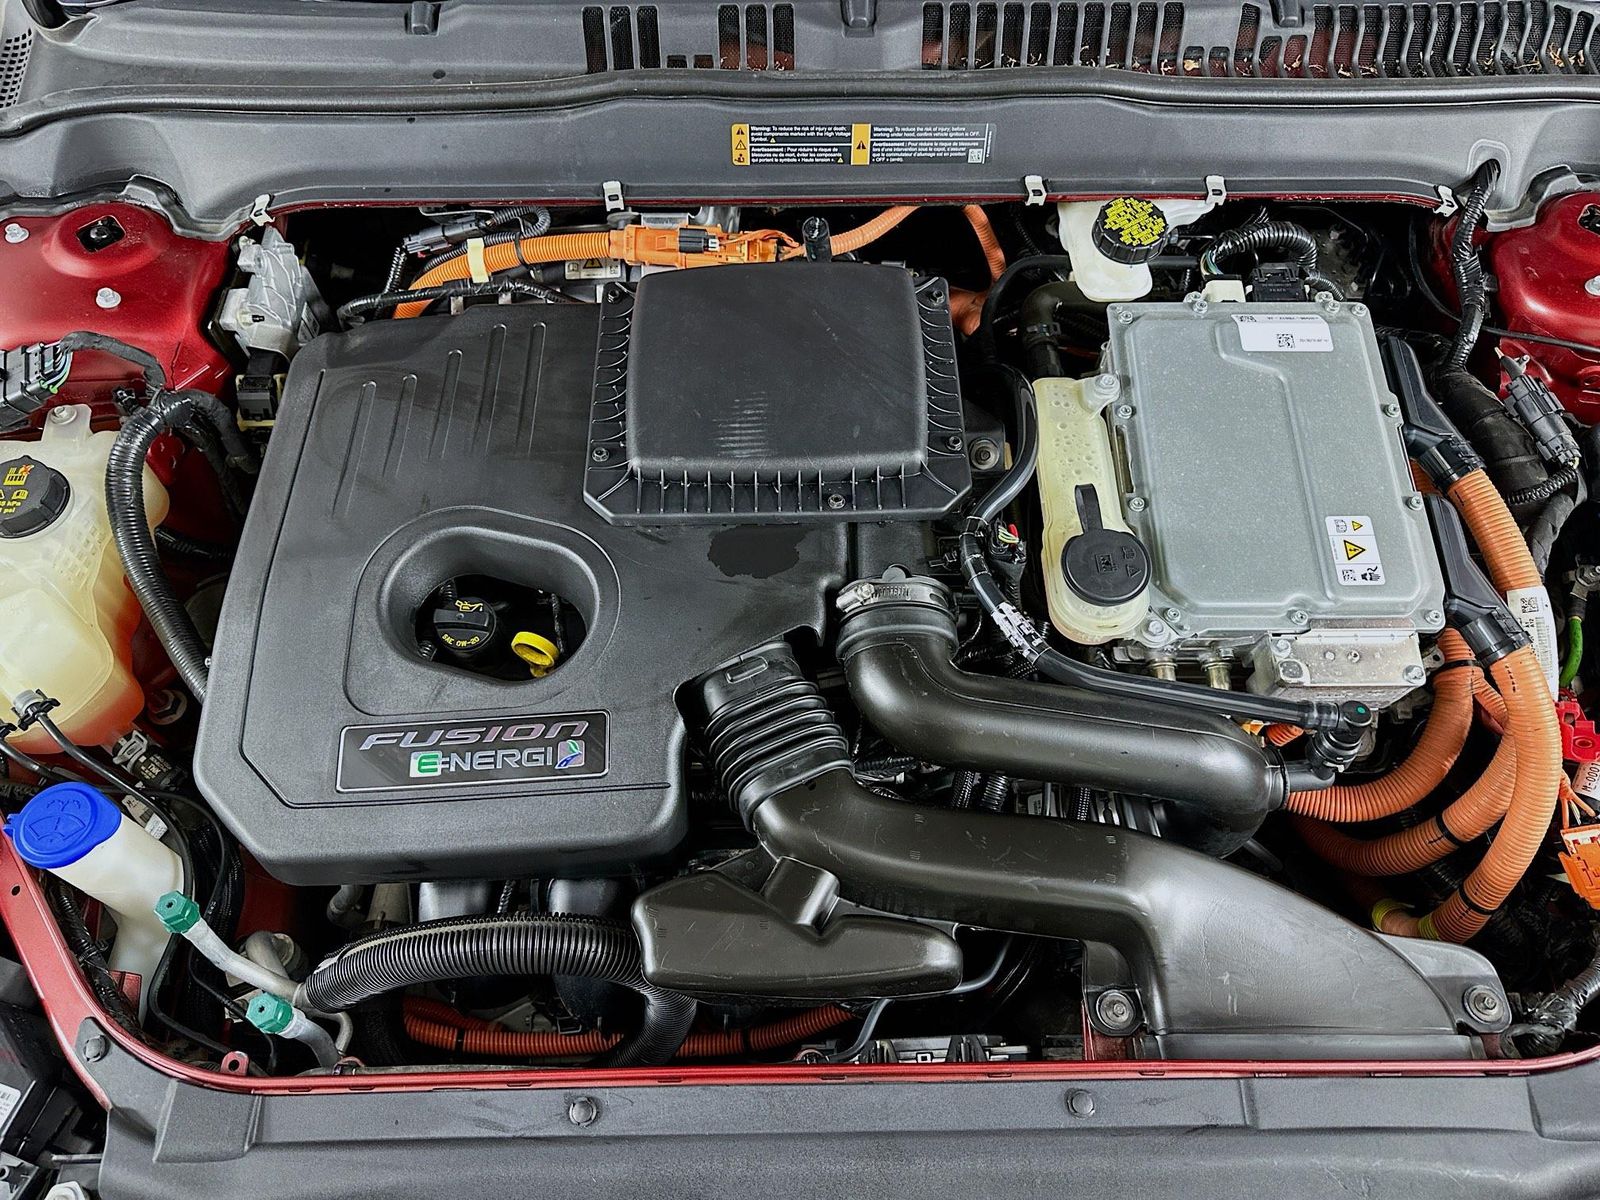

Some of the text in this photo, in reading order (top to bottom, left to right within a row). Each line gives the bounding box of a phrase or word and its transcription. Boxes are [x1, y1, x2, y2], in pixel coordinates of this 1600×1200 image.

[442, 634, 480, 647] SAE 0W-20
[359, 720, 589, 750] FUSION
